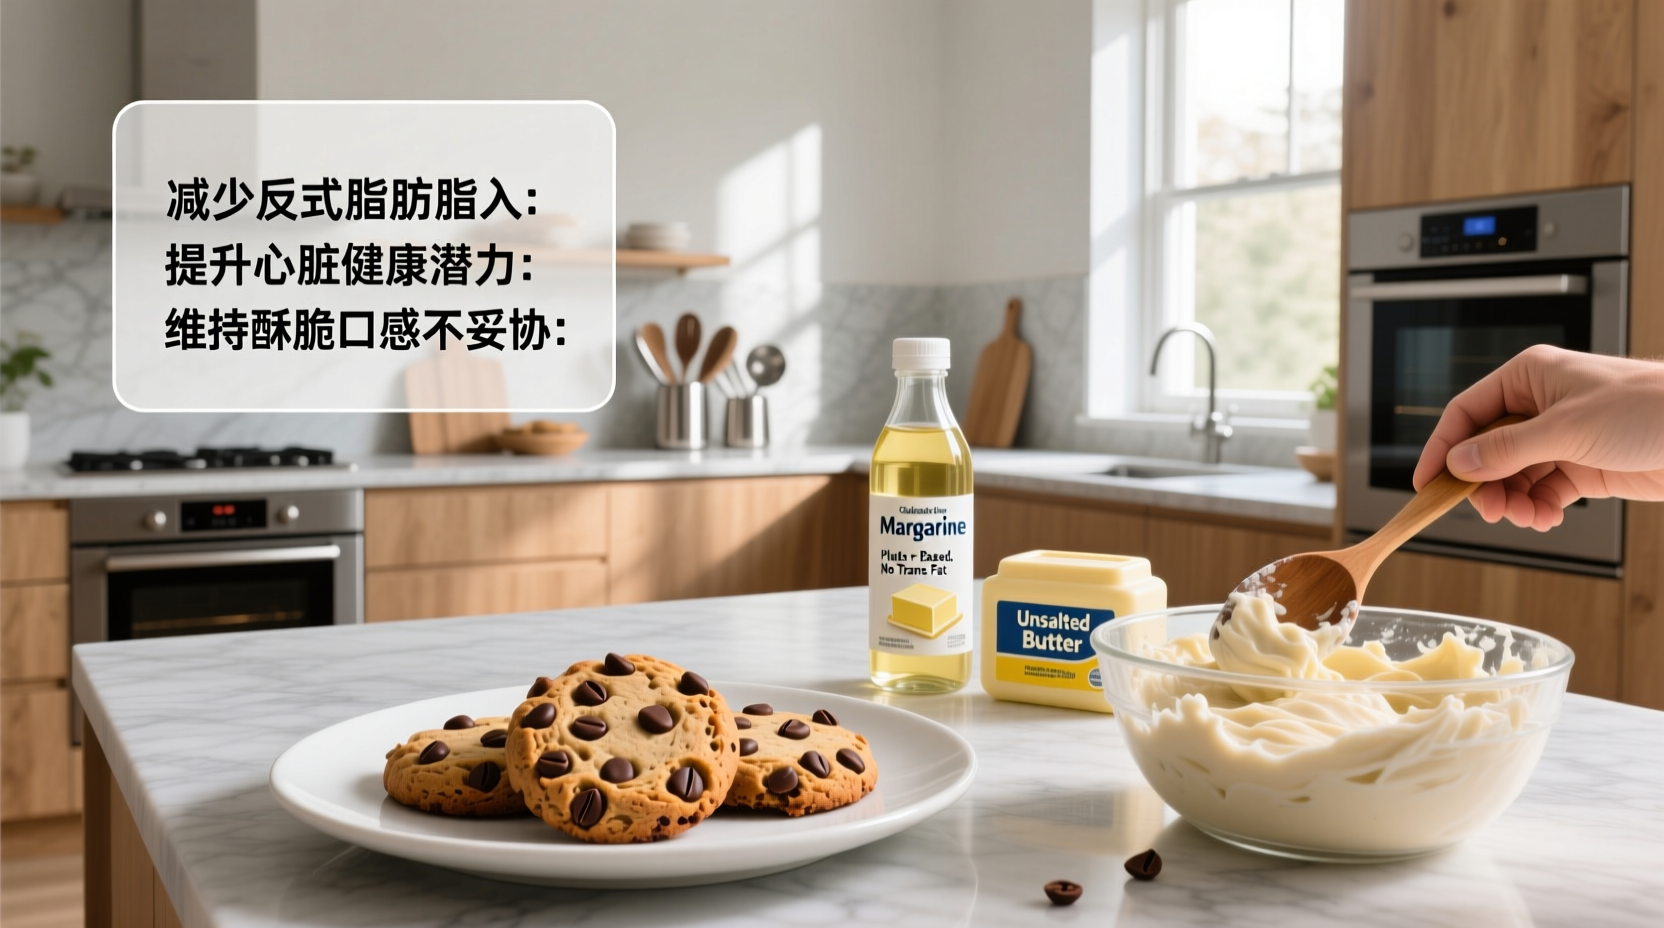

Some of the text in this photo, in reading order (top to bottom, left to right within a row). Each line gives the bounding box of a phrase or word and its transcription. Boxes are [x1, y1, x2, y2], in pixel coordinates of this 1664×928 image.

[880, 515, 967, 542] Margarine
[881, 563, 895, 575] No
[1017, 609, 1090, 632] Unsalted
[1022, 629, 1083, 653] Butter
